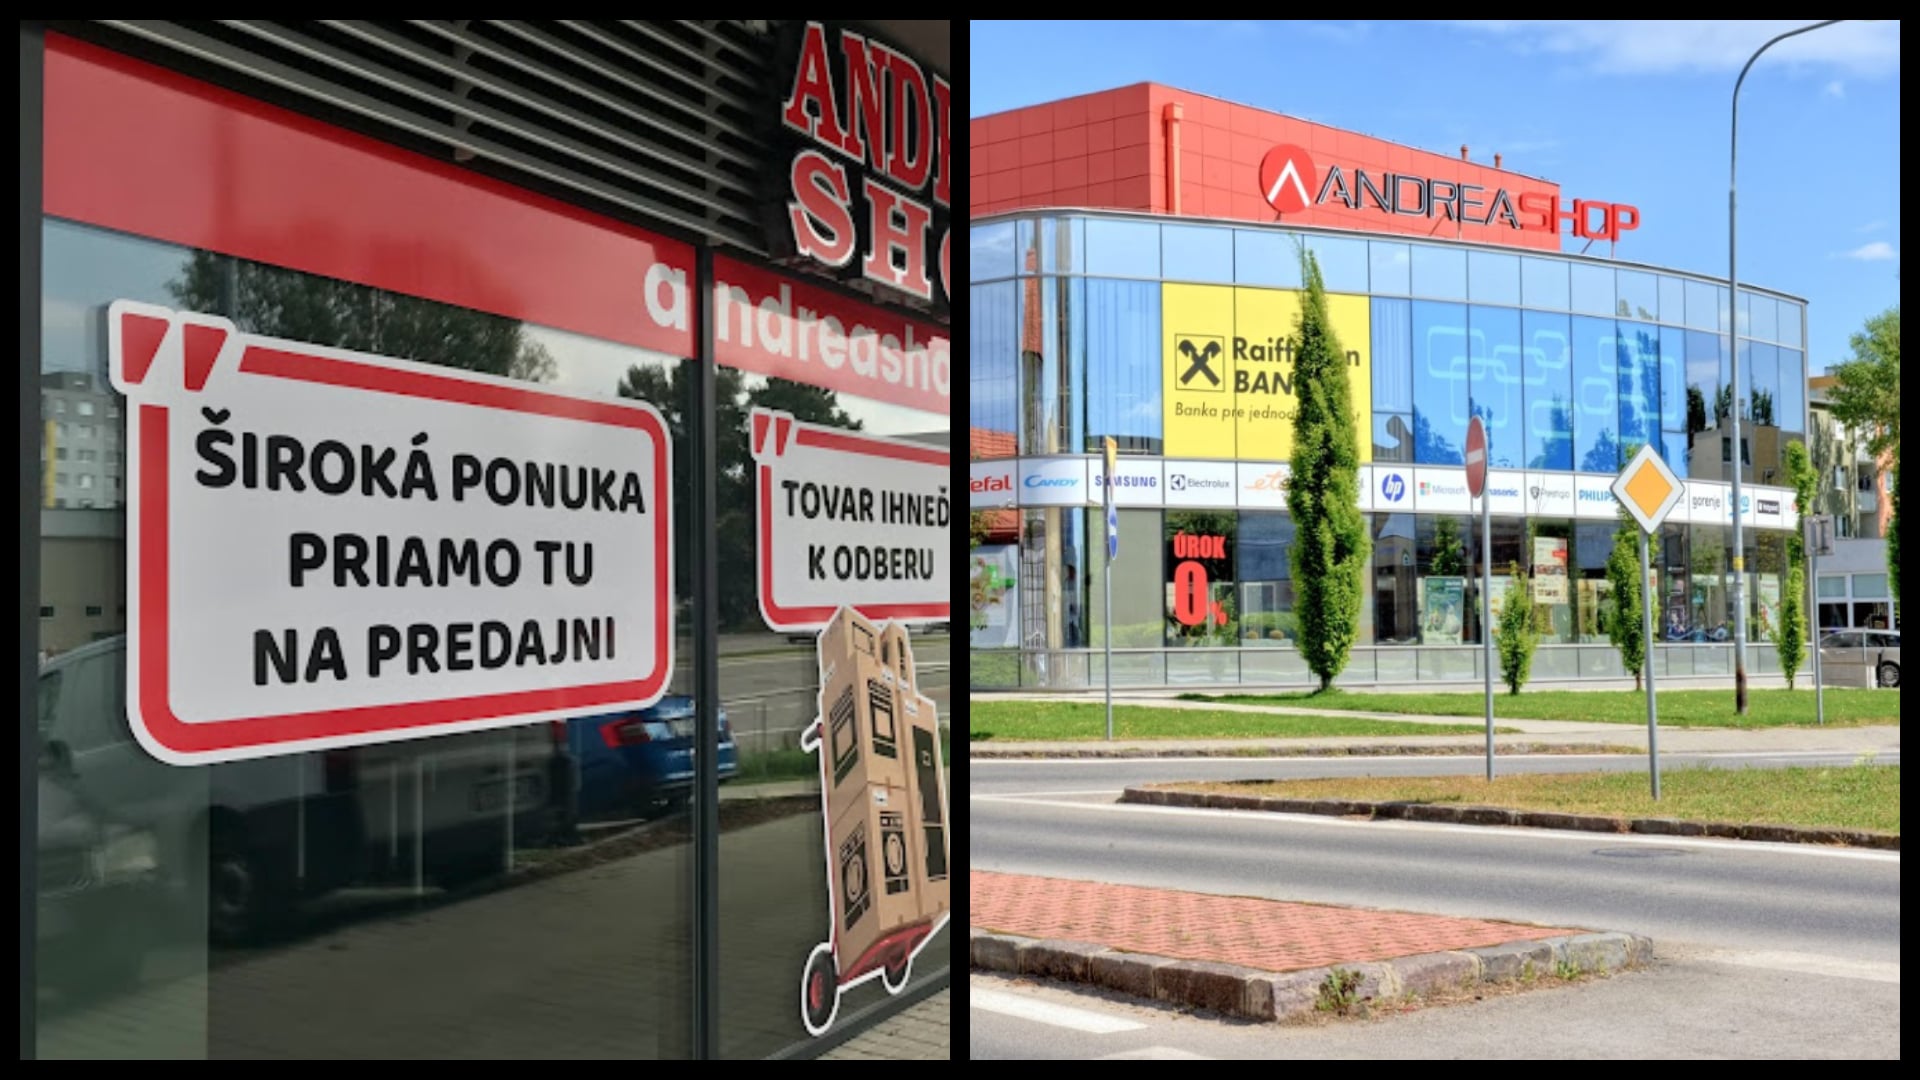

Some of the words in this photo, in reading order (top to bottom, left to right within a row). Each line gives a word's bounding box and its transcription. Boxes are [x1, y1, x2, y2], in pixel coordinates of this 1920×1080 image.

[782, 21, 950, 208] AND
[1315, 164, 1640, 242] ANDREASHOP
[789, 149, 950, 301] SH
[1232, 336, 1361, 367] Raiffn
[1234, 370, 1300, 396] BAN
[1175, 401, 1218, 418] Banka
[1222, 406, 1245, 422] pre
[195, 405, 438, 501] ŠIROKÁ
[452, 453, 647, 514] PONUKA
[970, 474, 1013, 493] efal
[1024, 474, 1079, 489] CANDY
[1187, 478, 1230, 489] Electrolux
[1384, 474, 1404, 502] hp
[1486, 487, 1519, 498] nasonic
[781, 479, 874, 523] TOVAR
[881, 485, 950, 528] IHNEĎ
[1692, 494, 1721, 511] gorenje
[1174, 531, 1226, 559] ÚROK
[289, 532, 522, 588] PRIAMO
[534, 540, 593, 586] TU
[808, 543, 827, 580] K
[833, 545, 935, 582] ODBERU
[253, 626, 348, 686] NA
[368, 616, 615, 678] PREDAJNI
